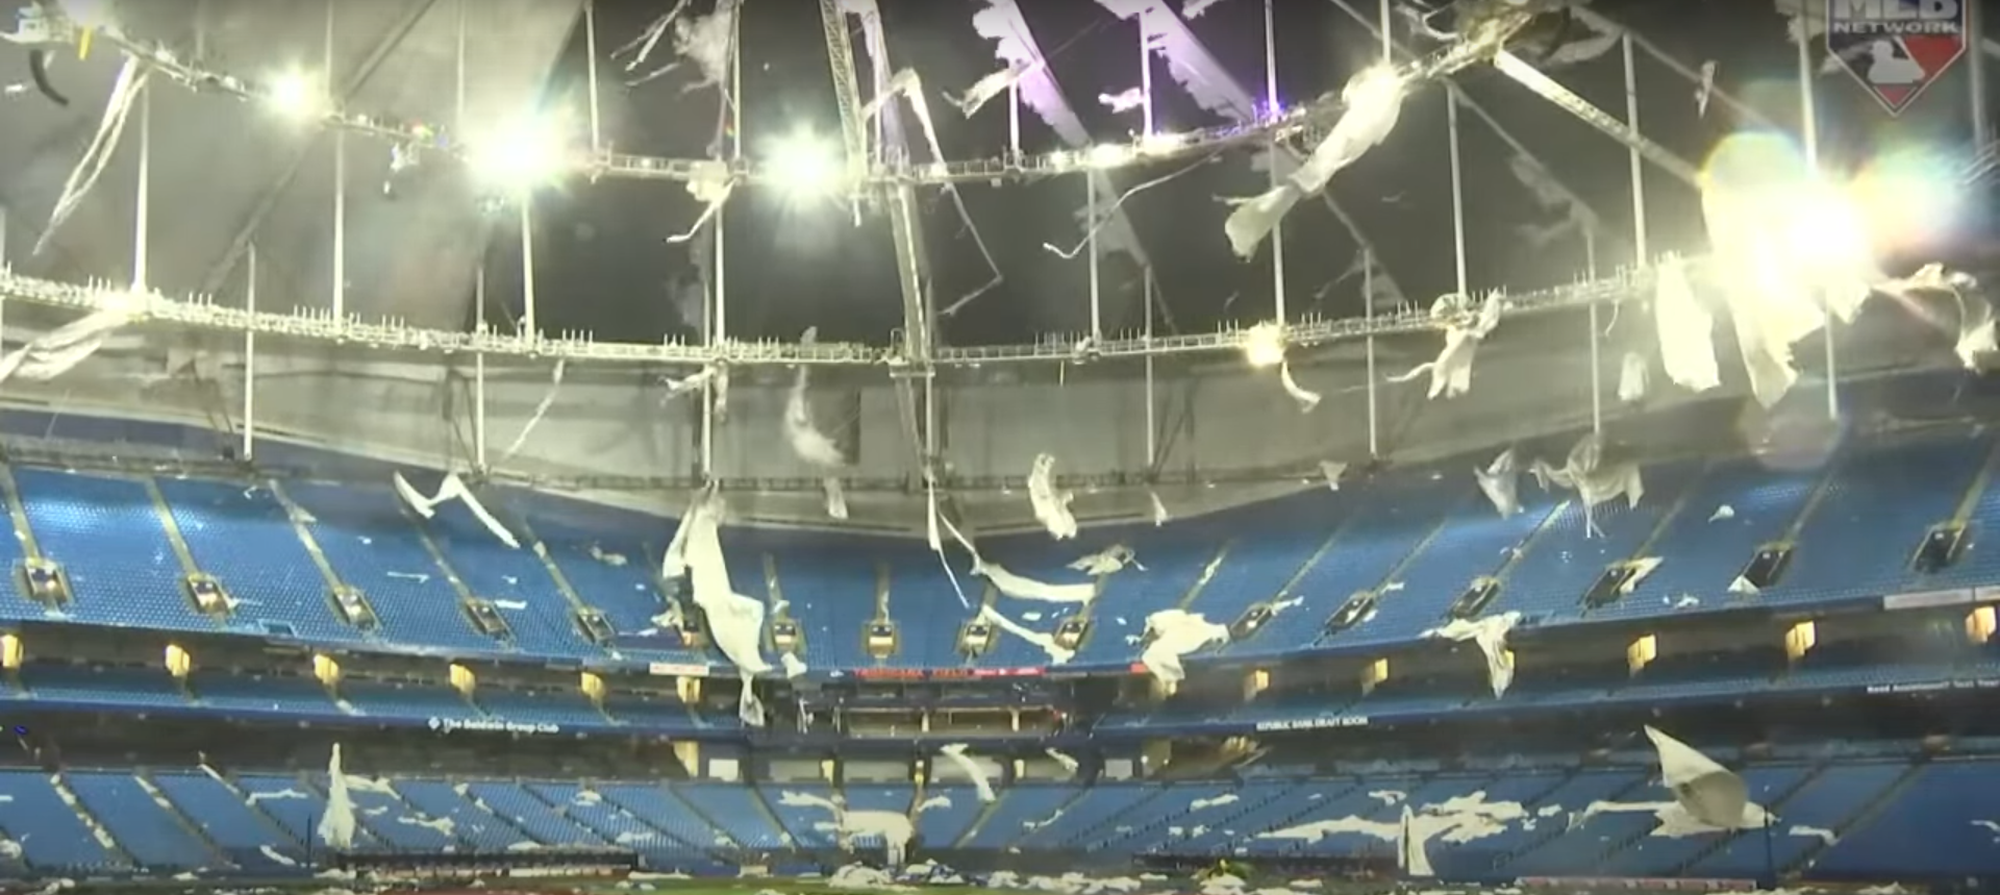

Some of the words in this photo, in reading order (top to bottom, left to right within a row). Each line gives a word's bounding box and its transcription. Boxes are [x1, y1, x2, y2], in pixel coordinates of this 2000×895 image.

[443, 718, 462, 729] The
[506, 721, 536, 734] Group
[537, 722, 560, 733] Club
